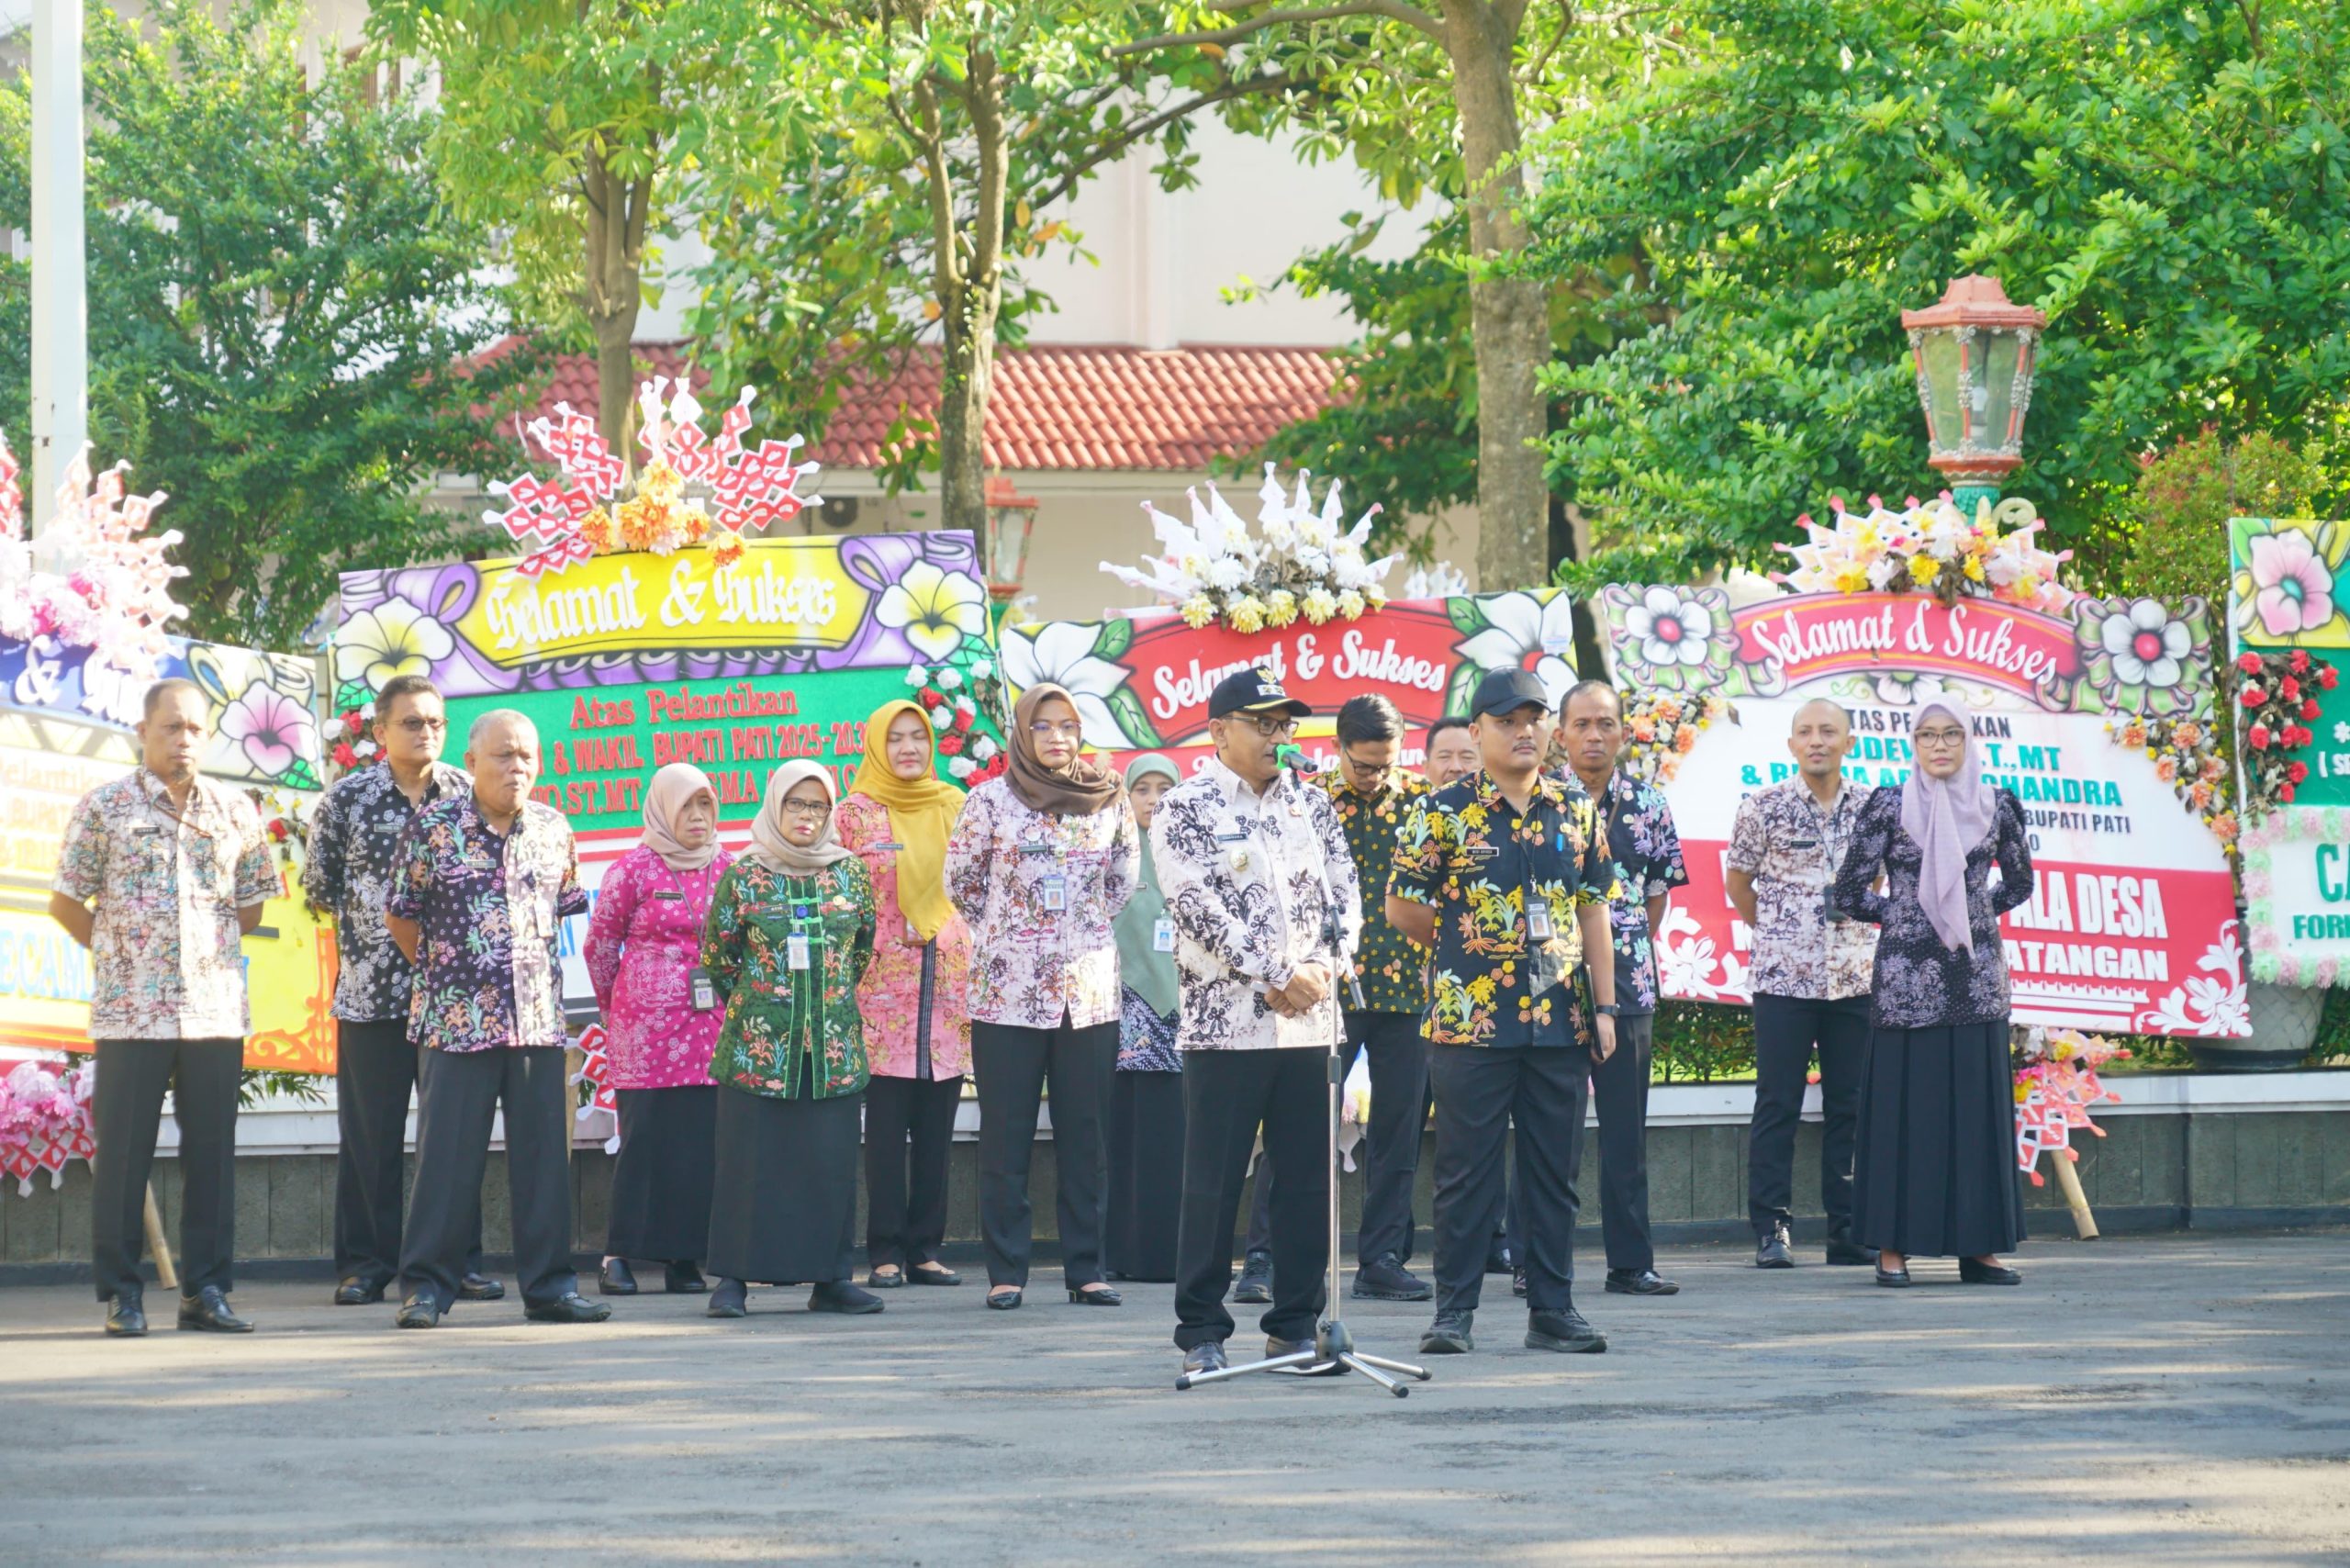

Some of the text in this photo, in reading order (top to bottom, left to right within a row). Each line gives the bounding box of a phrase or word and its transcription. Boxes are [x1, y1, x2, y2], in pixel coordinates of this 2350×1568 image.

[485, 559, 836, 649] Selamat & Sukses
[1295, 633, 1325, 680] &
[1333, 629, 1447, 692] Sukses
[1751, 602, 1897, 671] Selamat
[1943, 602, 2057, 685] Sukses
[570, 682, 800, 730] Atas Pelantikan
[1845, 709, 1886, 732] TAS
[554, 740, 569, 776] &
[573, 734, 644, 773] WAKIL
[653, 728, 724, 767] BUPATI
[732, 724, 776, 760] PATI
[777, 721, 867, 759] 2025-203
[1740, 765, 1762, 786] &
[2025, 809, 2132, 834] BUPATI PATI
[2075, 872, 2169, 938] DESA
[2293, 914, 2350, 940] FOR
[2002, 938, 2169, 982] ATANGAN
